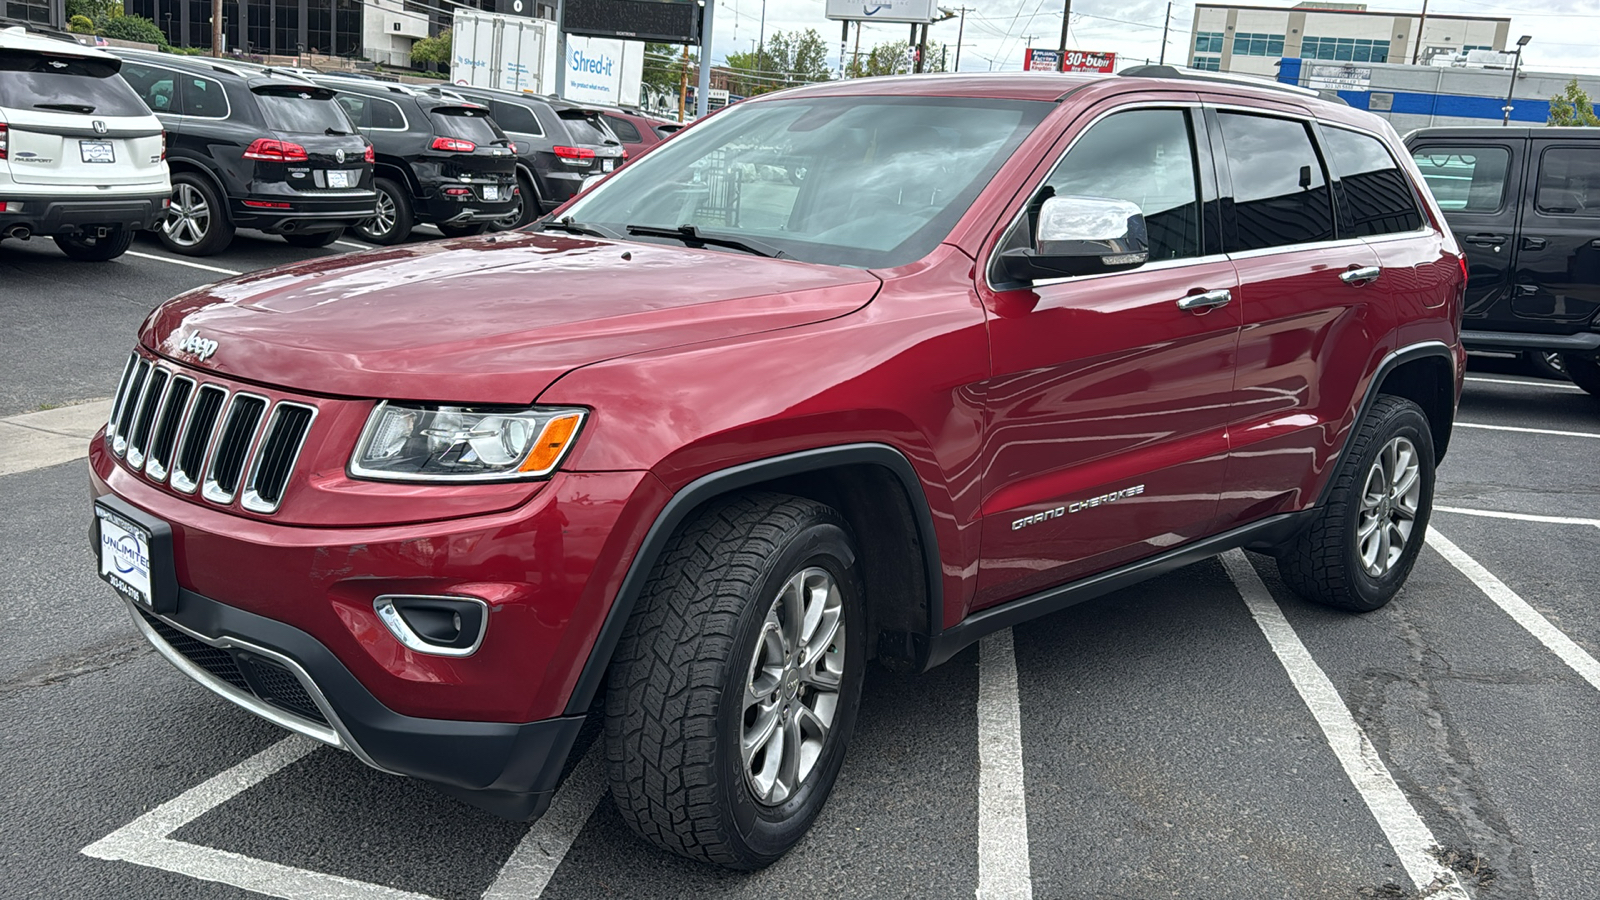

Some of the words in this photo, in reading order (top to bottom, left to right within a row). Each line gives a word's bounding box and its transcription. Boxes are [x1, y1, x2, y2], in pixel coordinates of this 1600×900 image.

[572, 50, 613, 77] Shred-it
[179, 329, 219, 362] Jeep
[1011, 506, 1066, 531] GRAND
[1068, 484, 1145, 514] CHEROKEE
[102, 533, 150, 569] UNLIMITED
